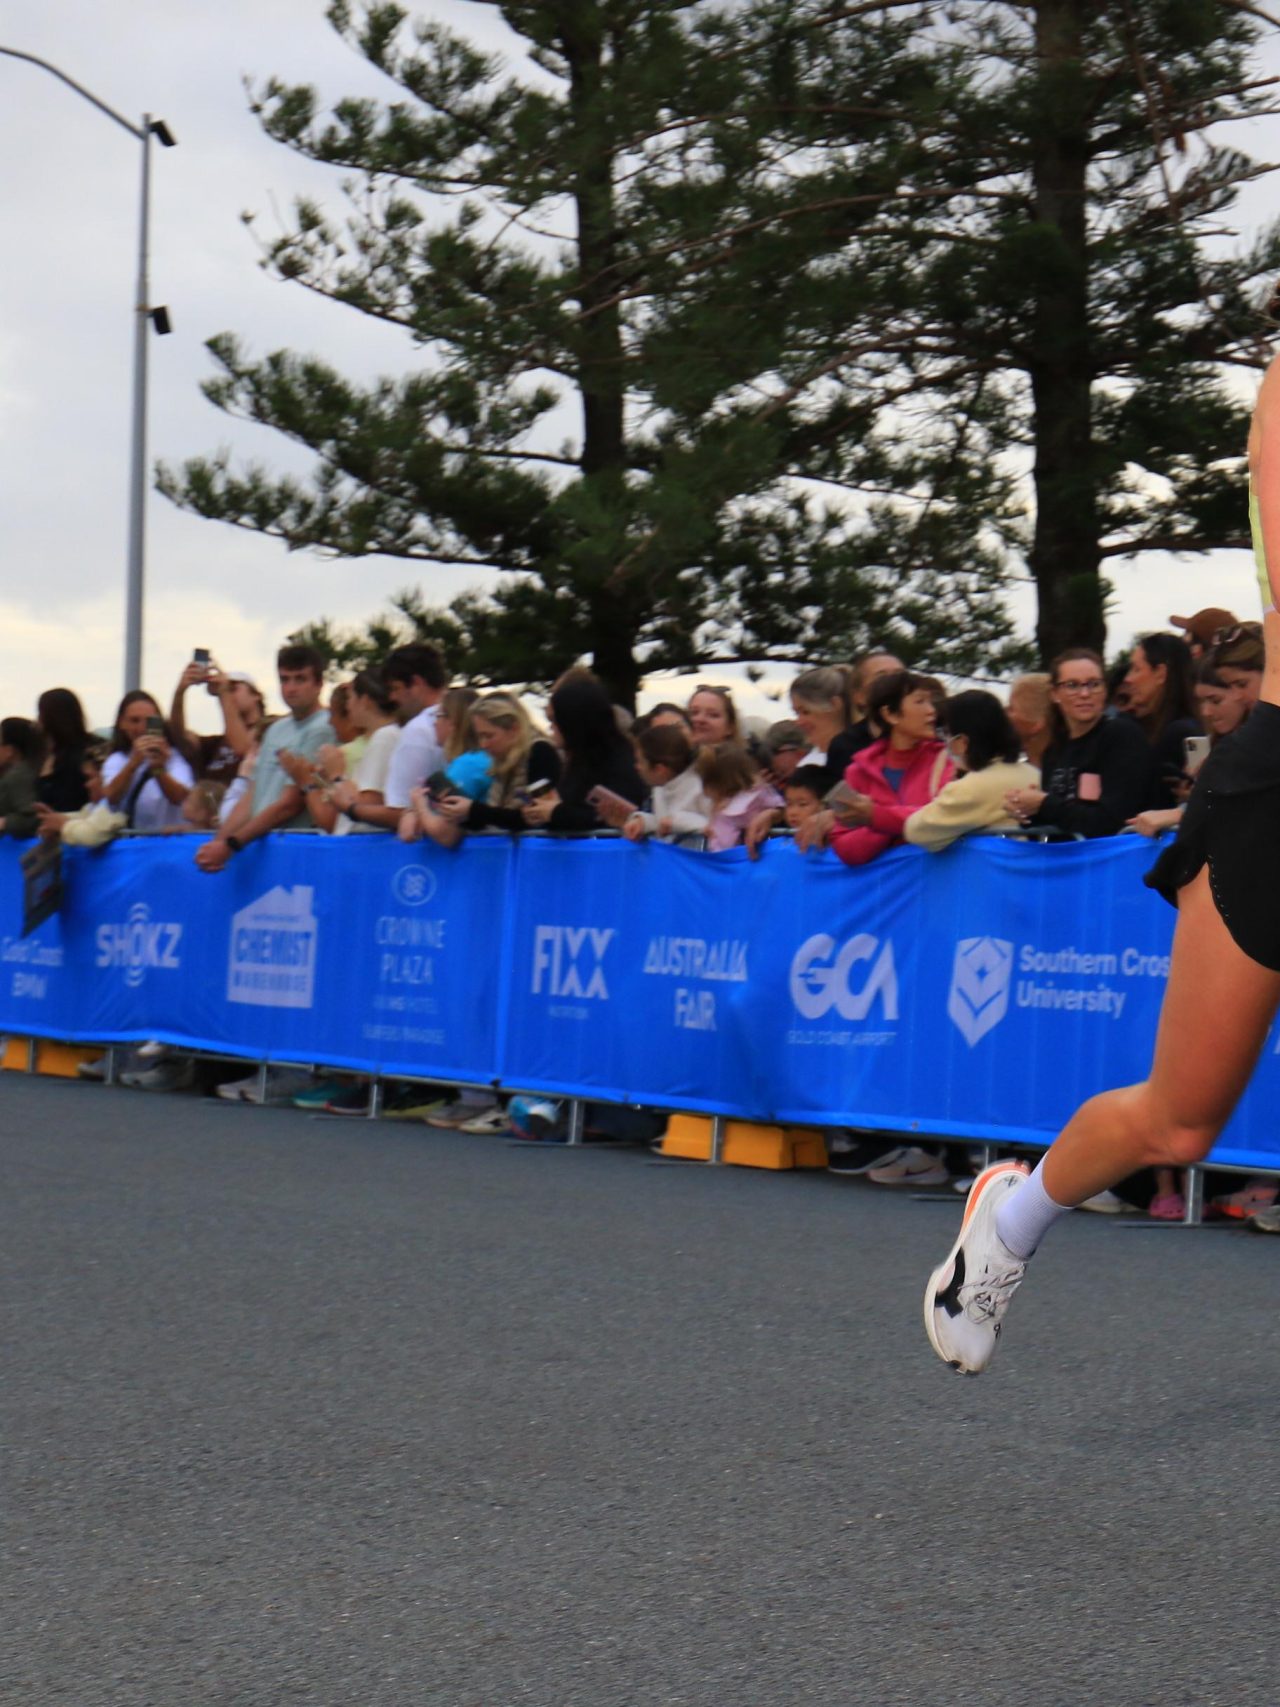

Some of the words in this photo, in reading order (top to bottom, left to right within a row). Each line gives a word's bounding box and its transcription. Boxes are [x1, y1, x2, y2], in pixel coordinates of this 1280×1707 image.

[96, 922, 182, 969] SHOKZ
[236, 928, 313, 968] CHEMIST
[531, 925, 616, 1000] FIXX
[643, 936, 748, 981] AUSTRALIA
[1020, 944, 1118, 975] Southern
[1120, 948, 1171, 977] Cros
[381, 953, 434, 984] PLAZA
[790, 933, 900, 1021] GCA
[674, 988, 717, 1030] FAIR
[1017, 980, 1126, 1020] University
